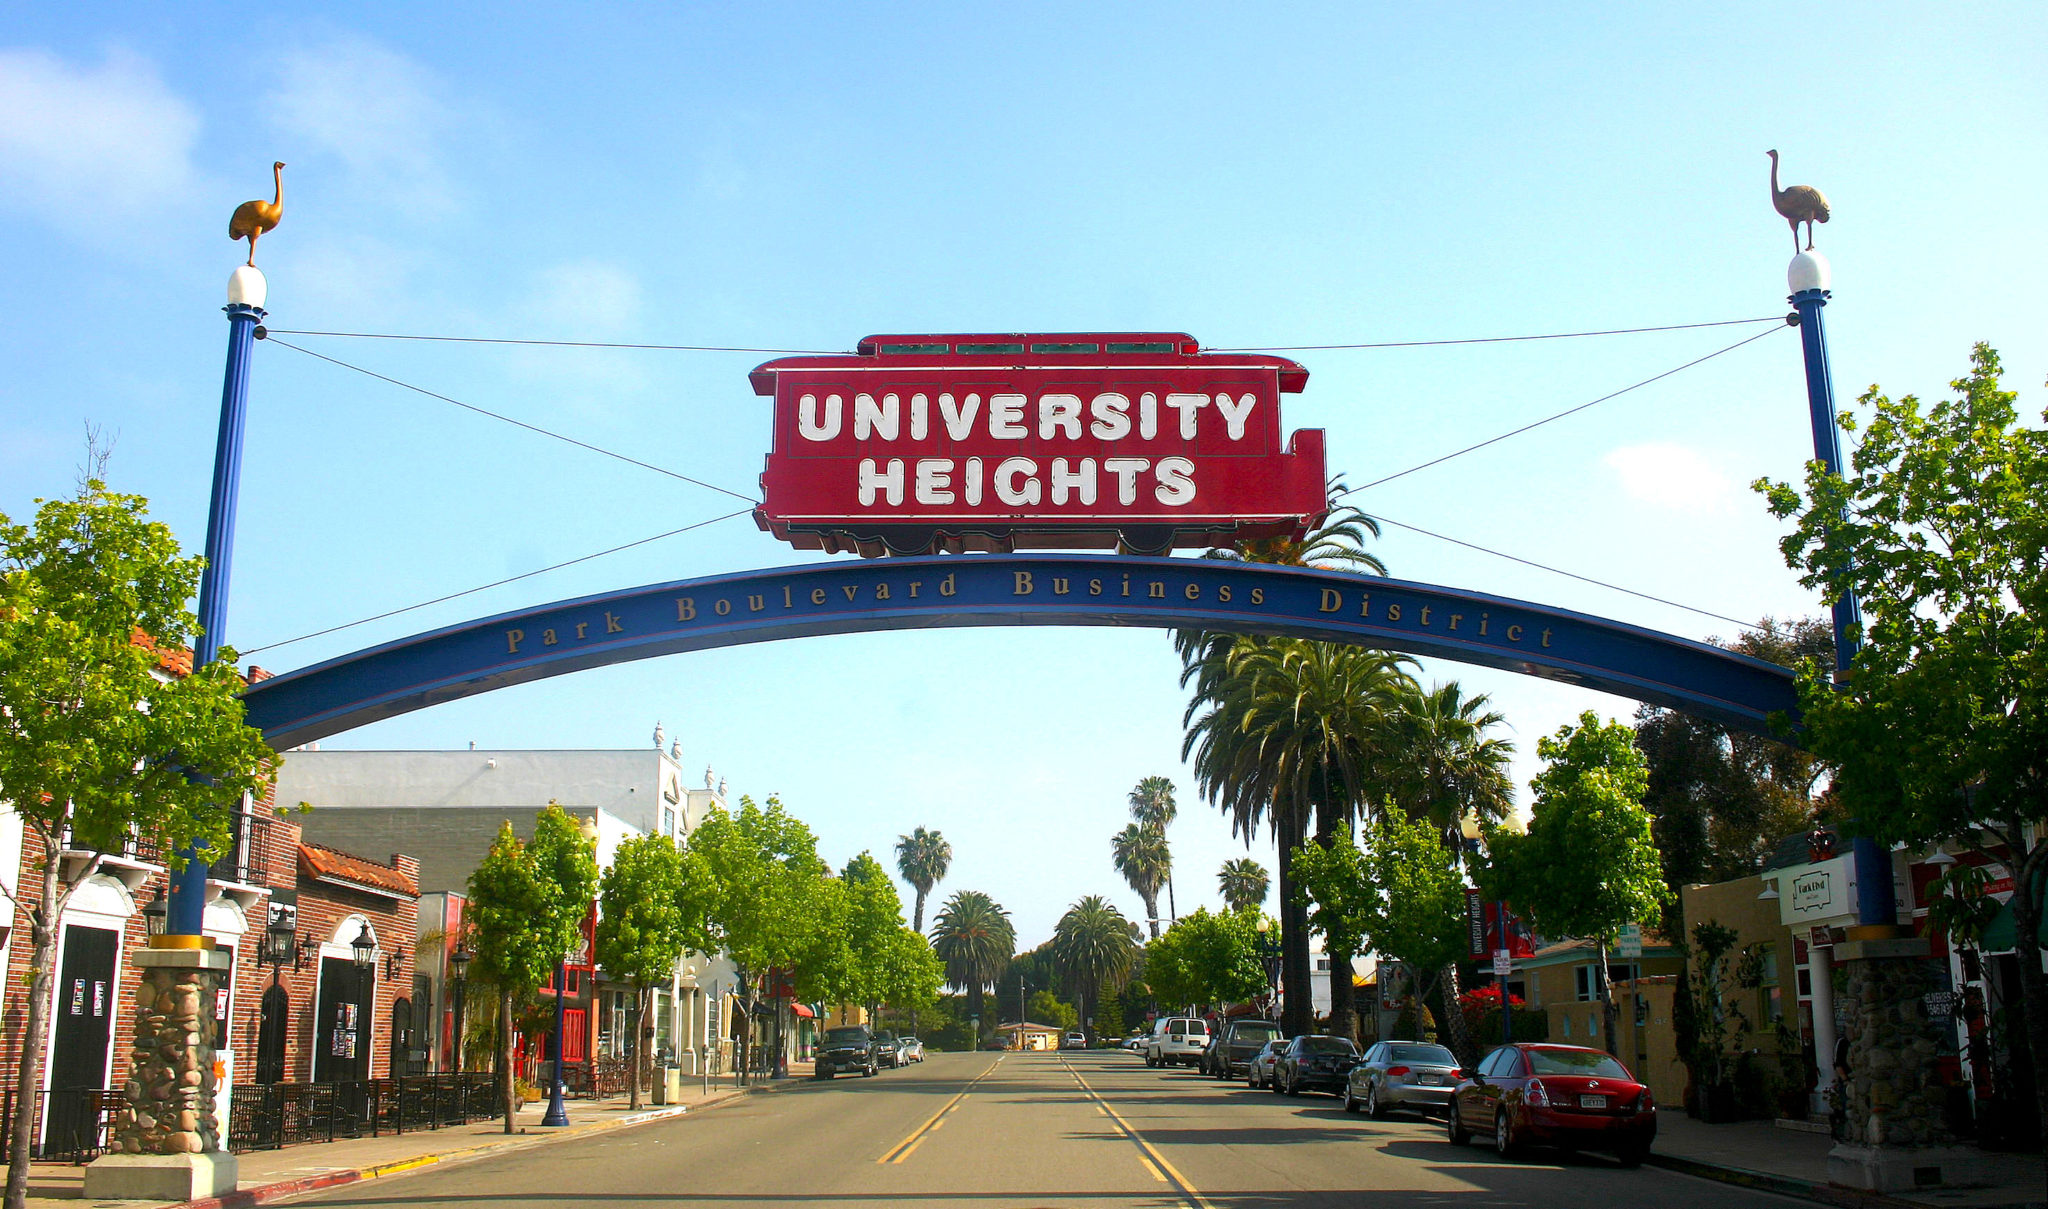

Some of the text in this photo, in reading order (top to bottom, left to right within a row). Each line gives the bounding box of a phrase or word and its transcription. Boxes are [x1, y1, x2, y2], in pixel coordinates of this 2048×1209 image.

[798, 391, 1257, 442] UNIVERSITY
[858, 456, 1197, 507] HEIGHTS
[506, 571, 1553, 653] Park Boulevard Business District
[1471, 894, 1483, 954] UNIVERSITY HEIGHTS
[1923, 991, 1951, 1004] ELIVERIES
